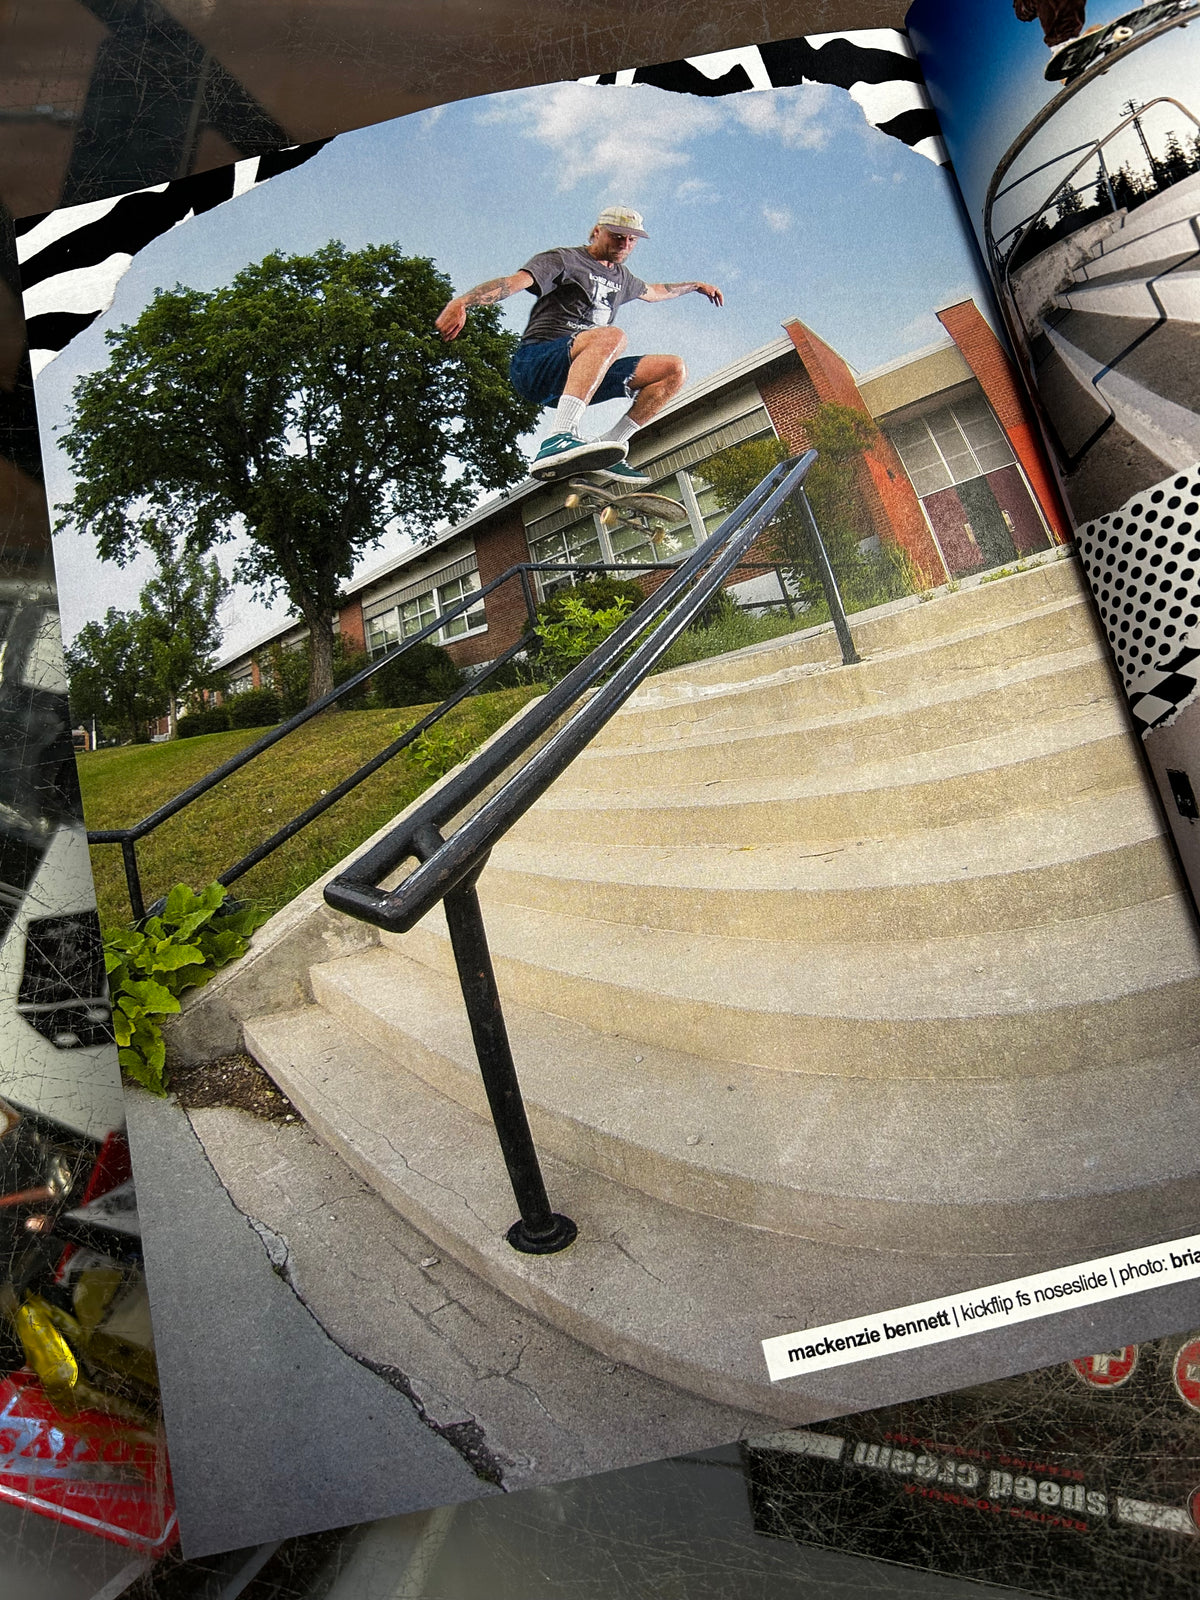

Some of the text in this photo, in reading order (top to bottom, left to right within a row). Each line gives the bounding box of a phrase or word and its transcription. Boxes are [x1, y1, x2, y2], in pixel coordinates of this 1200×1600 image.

[787, 1328, 881, 1362] mackenzie
[883, 1309, 951, 1340] bennett
[960, 1295, 1014, 1321] kickflip
[1015, 1290, 1032, 1308] fs
[1034, 1271, 1108, 1303] noseslide
[1118, 1257, 1169, 1286] photo:
[853, 1441, 1109, 1517] speed cream
[1010, 1507, 1088, 1532] RACING
